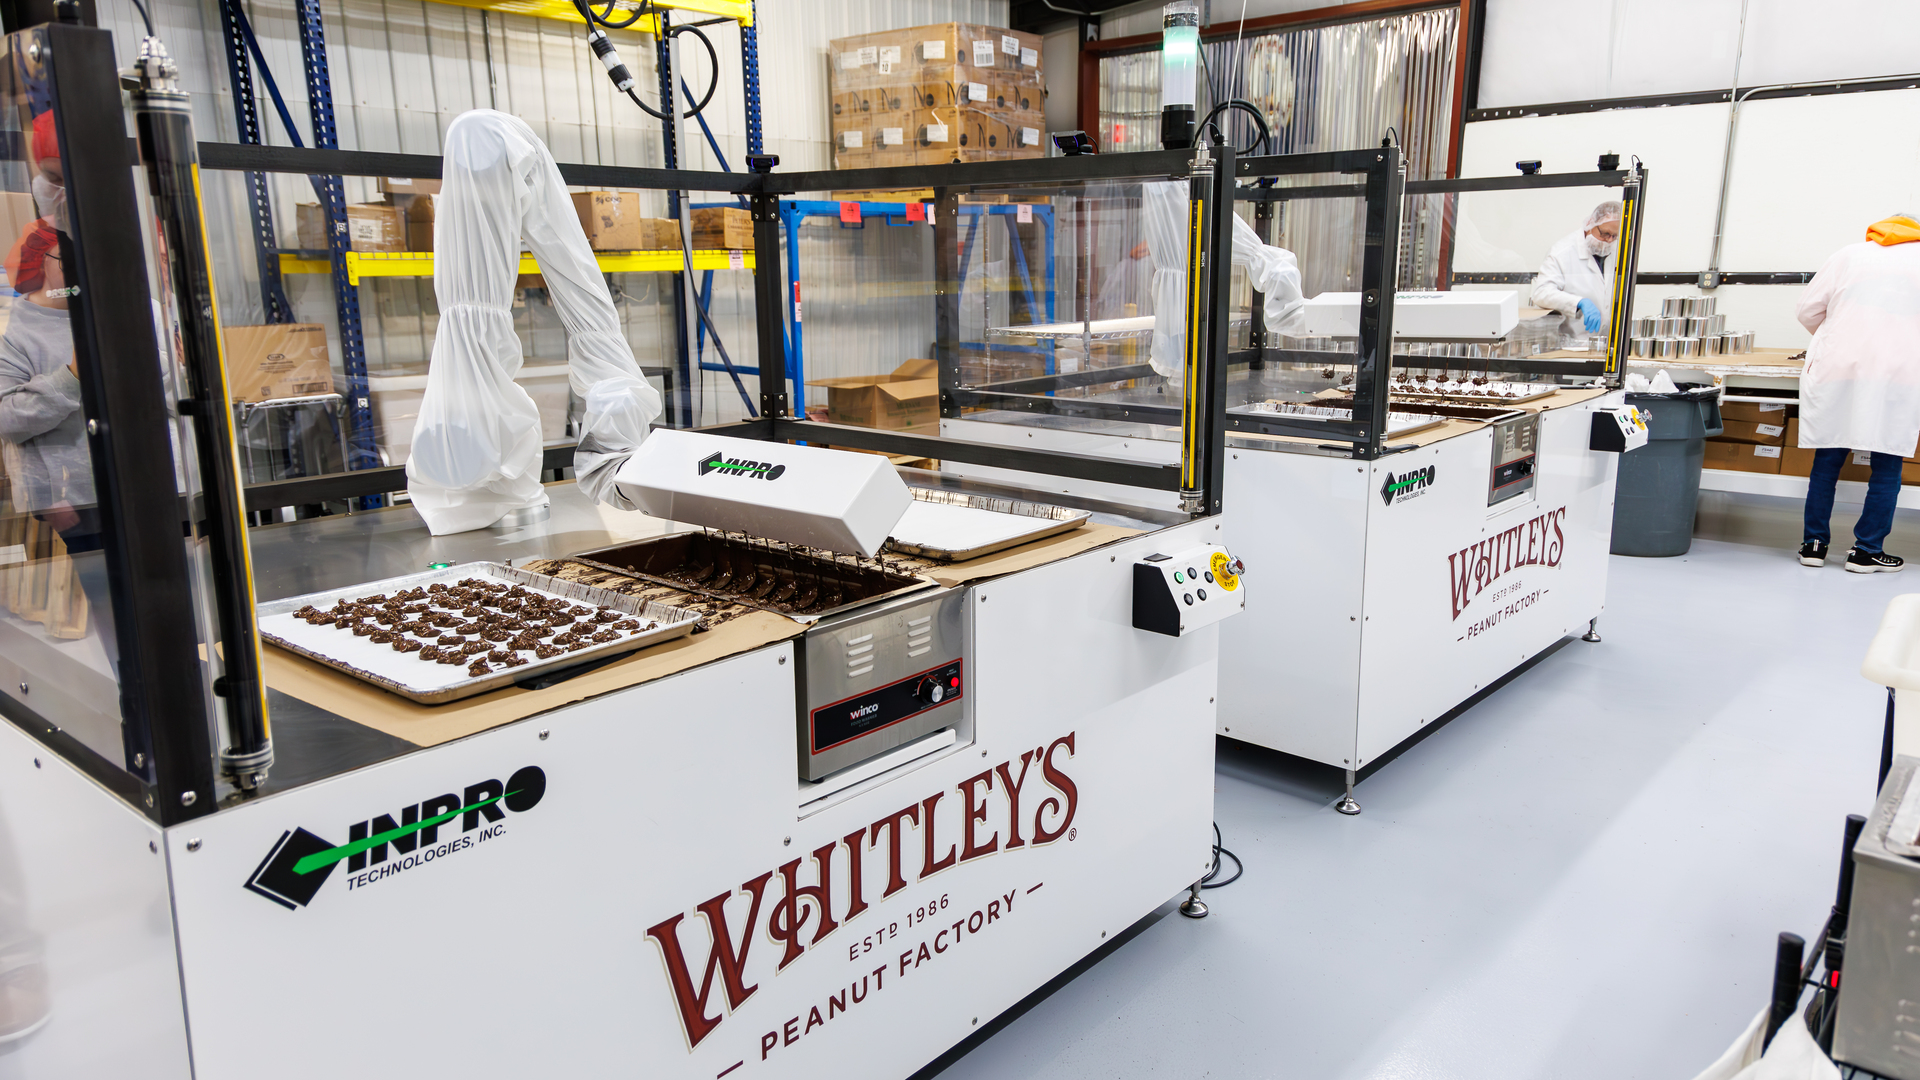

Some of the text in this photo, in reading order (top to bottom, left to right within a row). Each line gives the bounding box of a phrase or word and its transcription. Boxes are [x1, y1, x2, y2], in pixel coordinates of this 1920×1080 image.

[717, 457, 786, 481] INPRO
[1397, 464, 1436, 496] INPRO
[1447, 505, 1566, 622] WHITLEY'S
[1509, 580, 1521, 594] 1986
[1467, 588, 1541, 640] PEANUT FACTORY
[850, 703, 879, 720] winco
[347, 765, 547, 875] INPRO
[347, 824, 507, 891] TECHNOLOGIES, INC.
[643, 730, 1079, 1054] WHITLEY'S
[906, 892, 950, 929] 1986
[761, 888, 1017, 1062] PEANUT FACTORY
